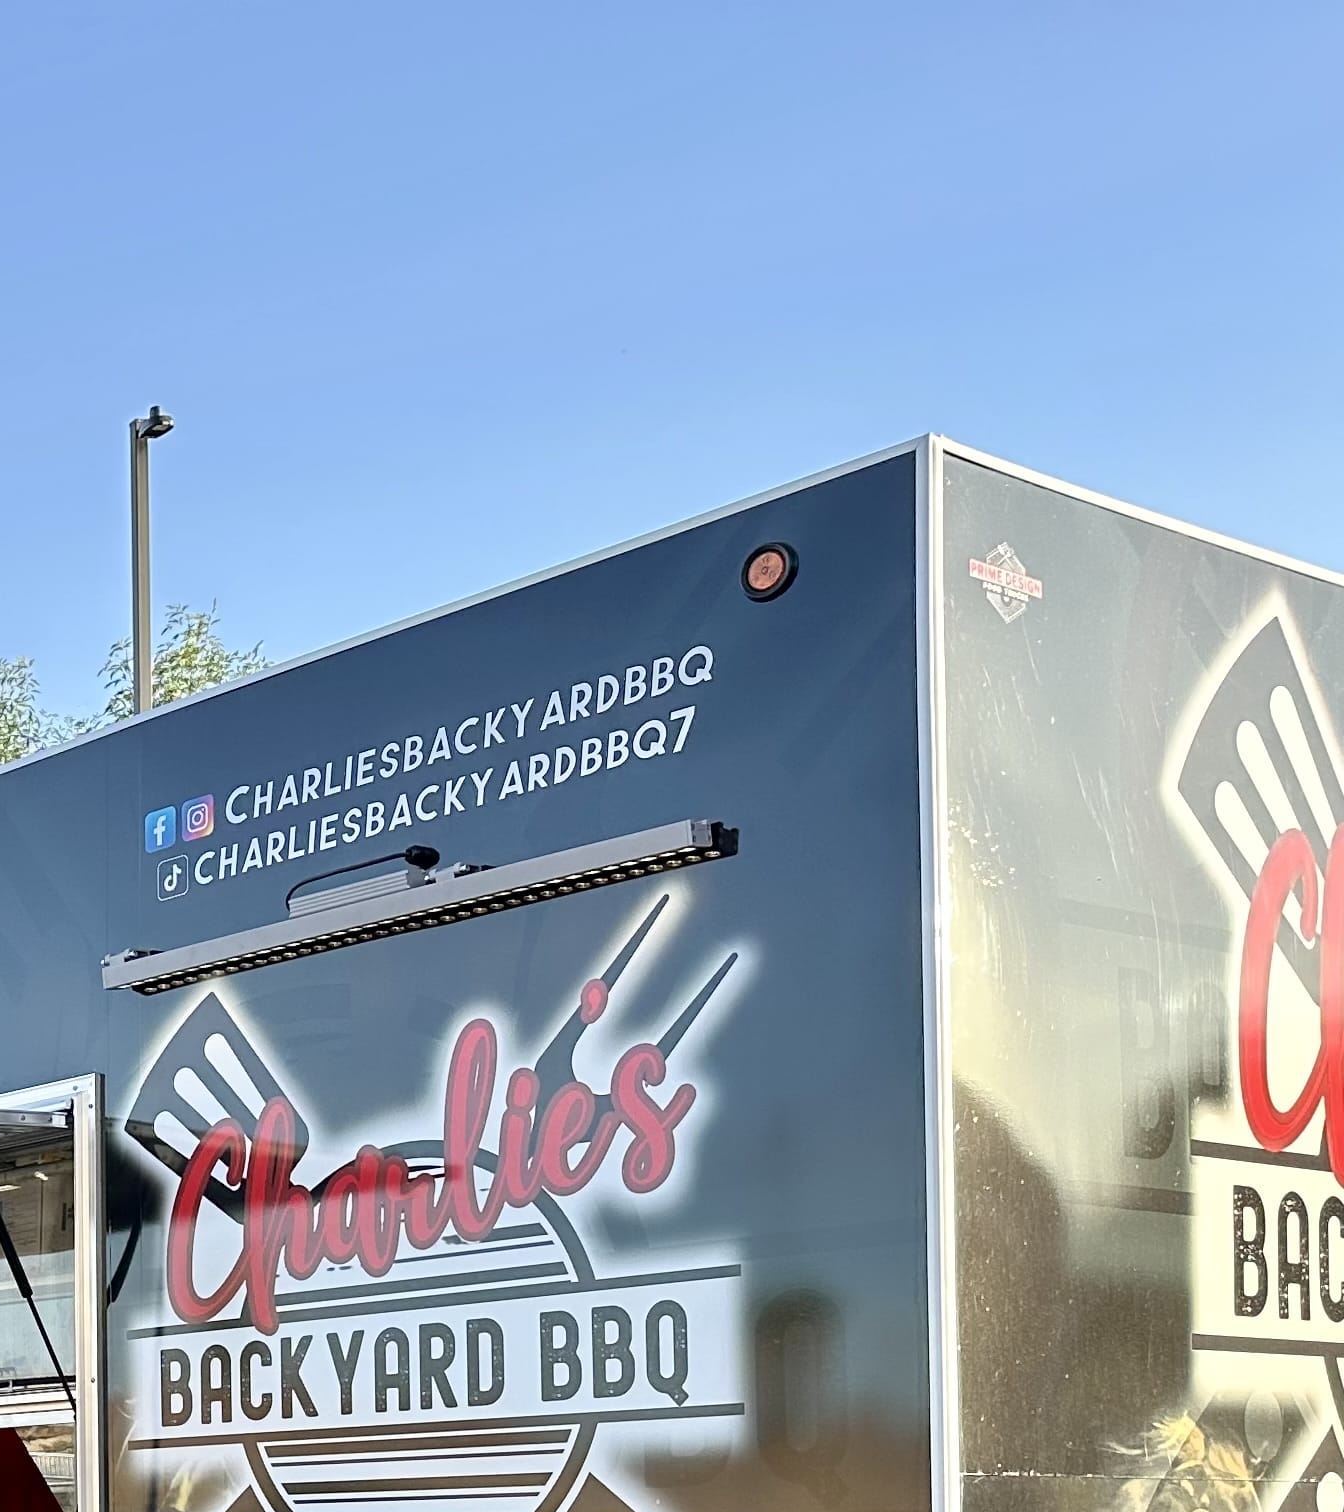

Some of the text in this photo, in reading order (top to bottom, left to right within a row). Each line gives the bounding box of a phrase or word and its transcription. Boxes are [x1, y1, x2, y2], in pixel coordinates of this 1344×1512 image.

[971, 561, 1041, 593] PRIME DESIGN
[194, 706, 696, 886] CHARLIESBACKYARDBBQ7
[224, 645, 715, 828] CHARLIESBACKYARDBBQ
[160, 1317, 505, 1429] BACKYARD
[540, 1299, 690, 1407] BBQ
